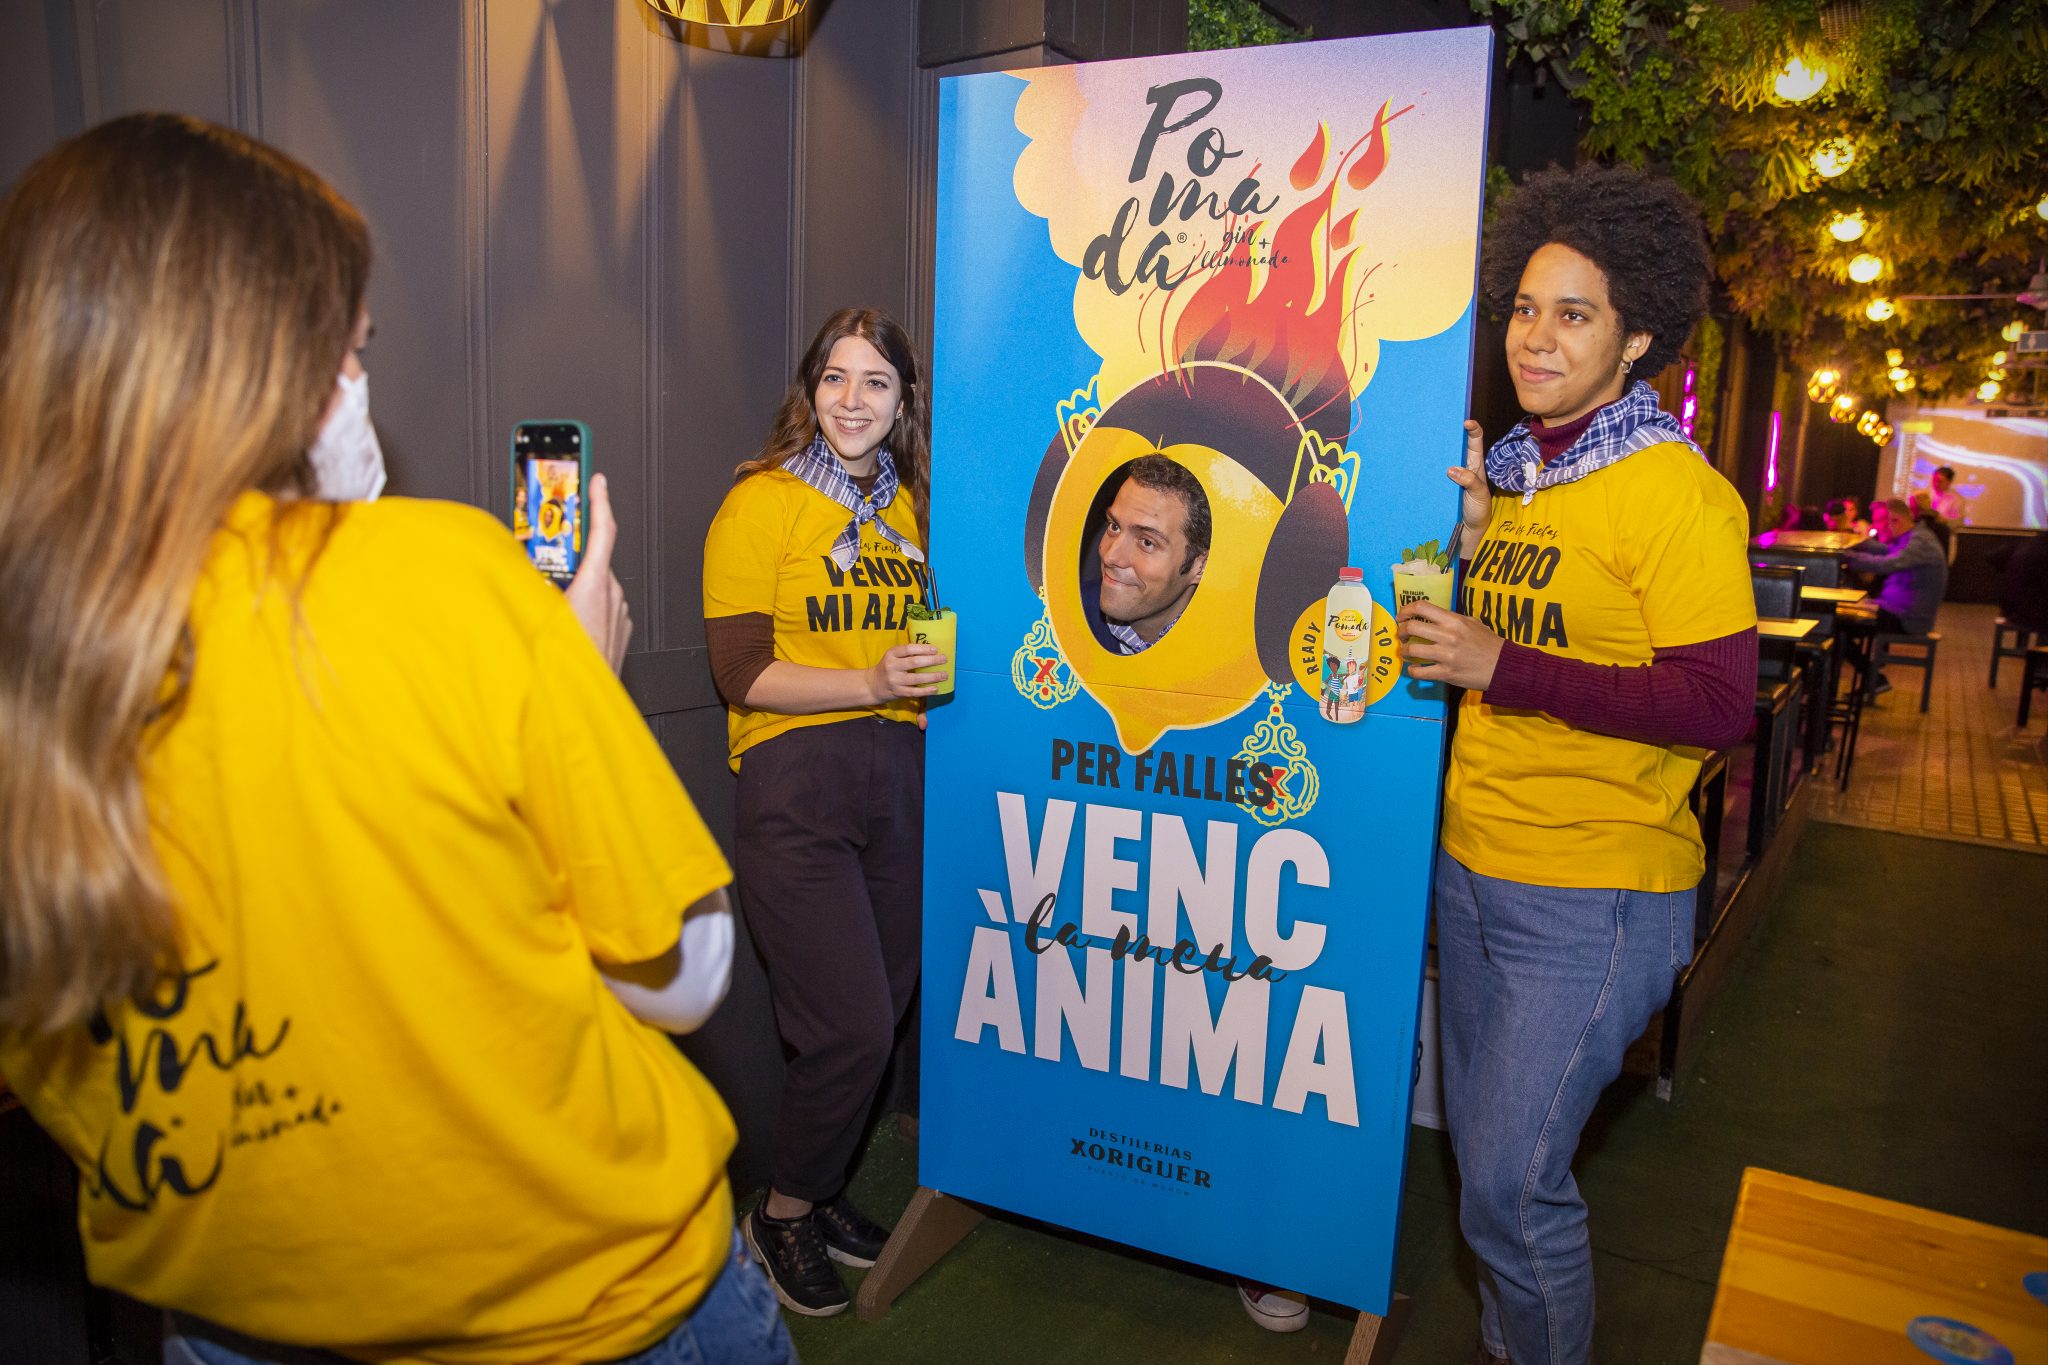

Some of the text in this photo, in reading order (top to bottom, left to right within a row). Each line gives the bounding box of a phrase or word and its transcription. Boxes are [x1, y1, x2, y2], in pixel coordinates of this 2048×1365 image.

[1201, 250, 1289, 269] llimonada
[1221, 225, 1257, 253] gin
[821, 555, 928, 588] VENDO
[1469, 540, 1561, 590] VENDO
[806, 593, 853, 633] MI
[1328, 615, 1369, 631] Pomada
[1375, 626, 1393, 647] TO
[1480, 590, 1568, 648] ALMA
[1302, 622, 1321, 675] READY
[1371, 655, 1393, 684] GO!
[1052, 738, 1274, 807] PER FALLES
[997, 791, 1330, 971] VENC
[1025, 893, 1288, 983] la meua
[954, 889, 1359, 1128] ÀNIMA
[1071, 1138, 1211, 1188] XORIGUER
